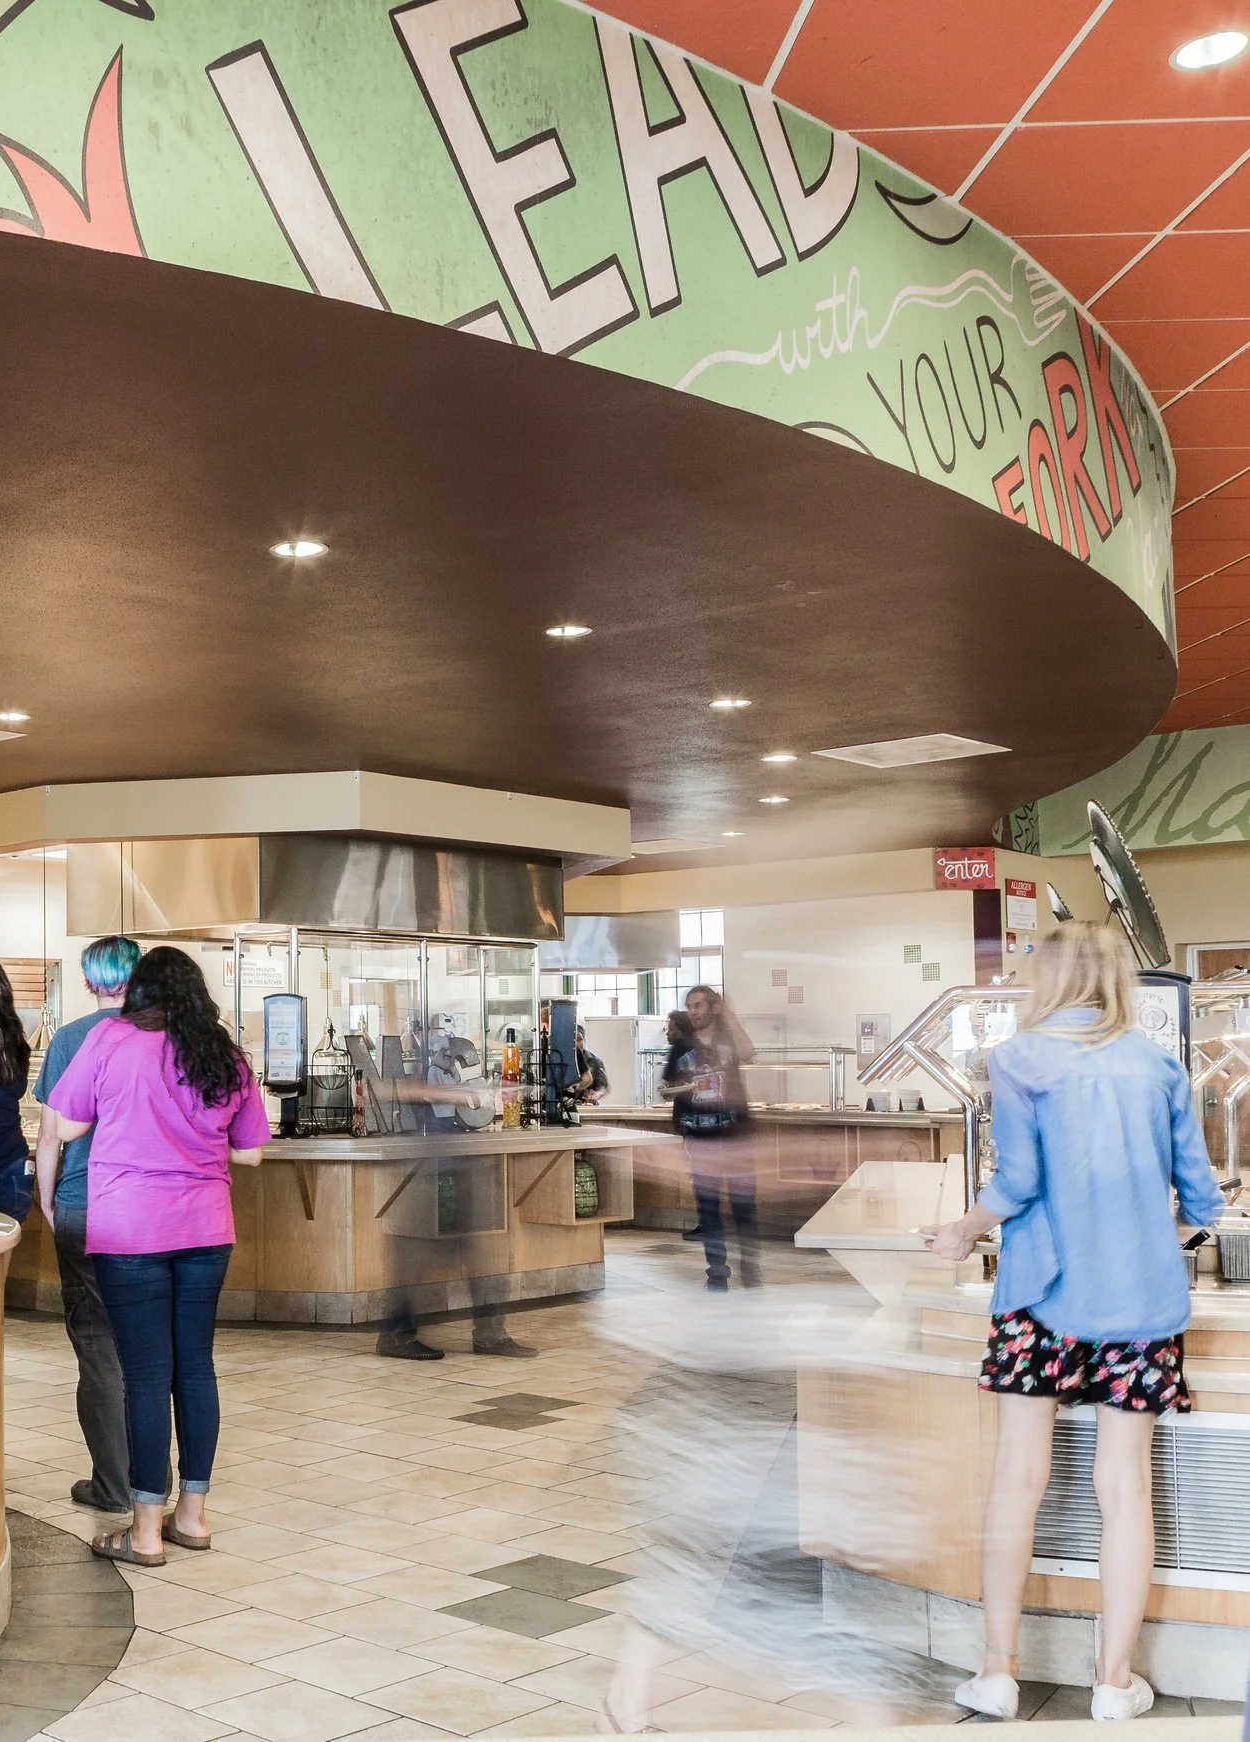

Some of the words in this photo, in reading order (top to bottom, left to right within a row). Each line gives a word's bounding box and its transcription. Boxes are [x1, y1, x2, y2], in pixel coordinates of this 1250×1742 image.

[207, 0, 973, 356] LEAD
[772, 264, 892, 376] with
[866, 315, 1022, 476] YOUR
[991, 305, 1143, 565] FORK
[944, 857, 994, 880] enter
